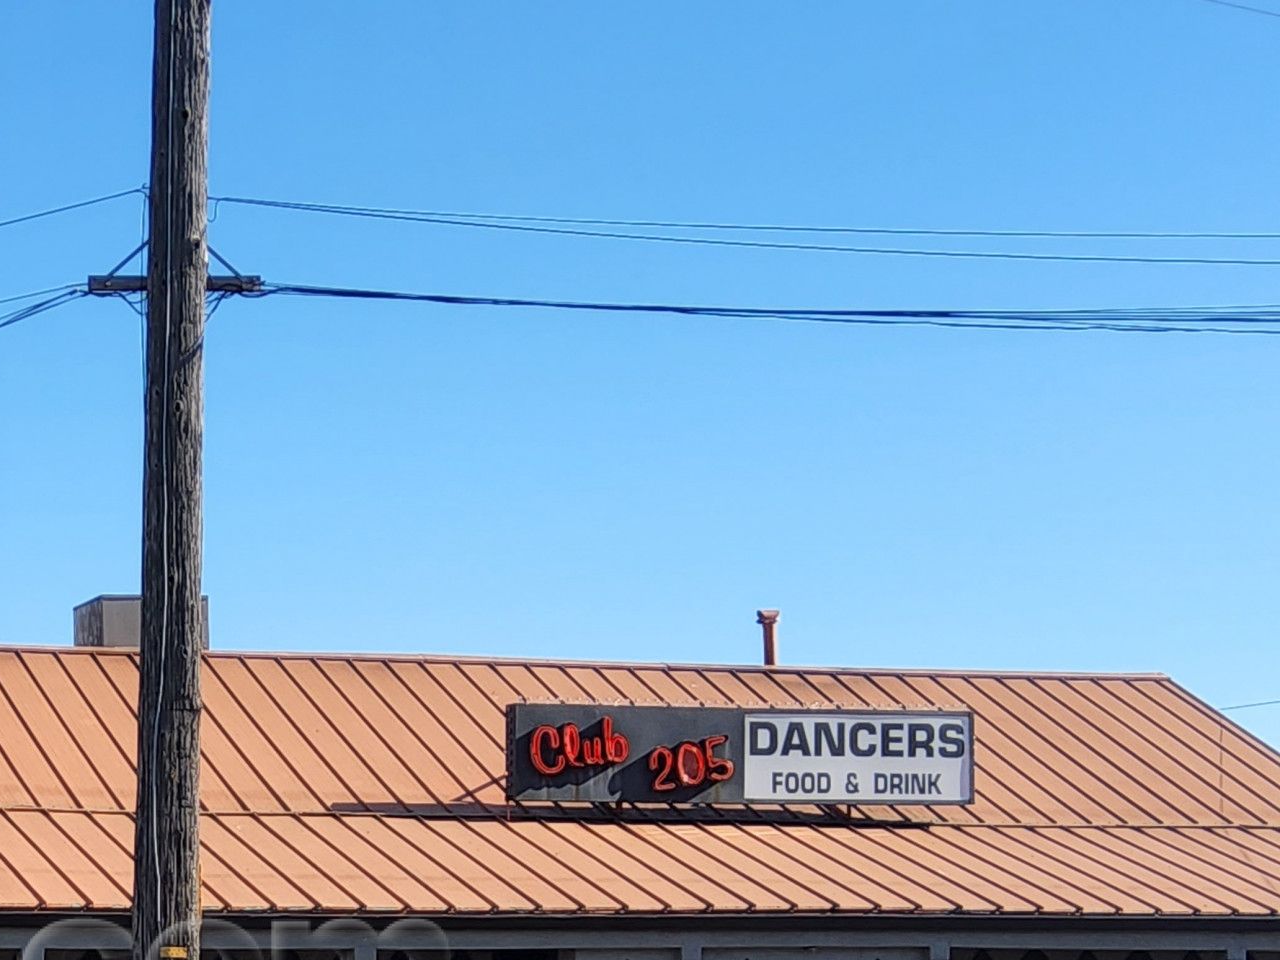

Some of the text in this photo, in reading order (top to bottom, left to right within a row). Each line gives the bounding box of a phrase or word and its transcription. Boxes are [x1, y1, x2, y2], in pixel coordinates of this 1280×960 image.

[530, 716, 735, 792] Club 205
[749, 721, 965, 759] DANCERS
[771, 772, 942, 795] FOOD & DRINK
